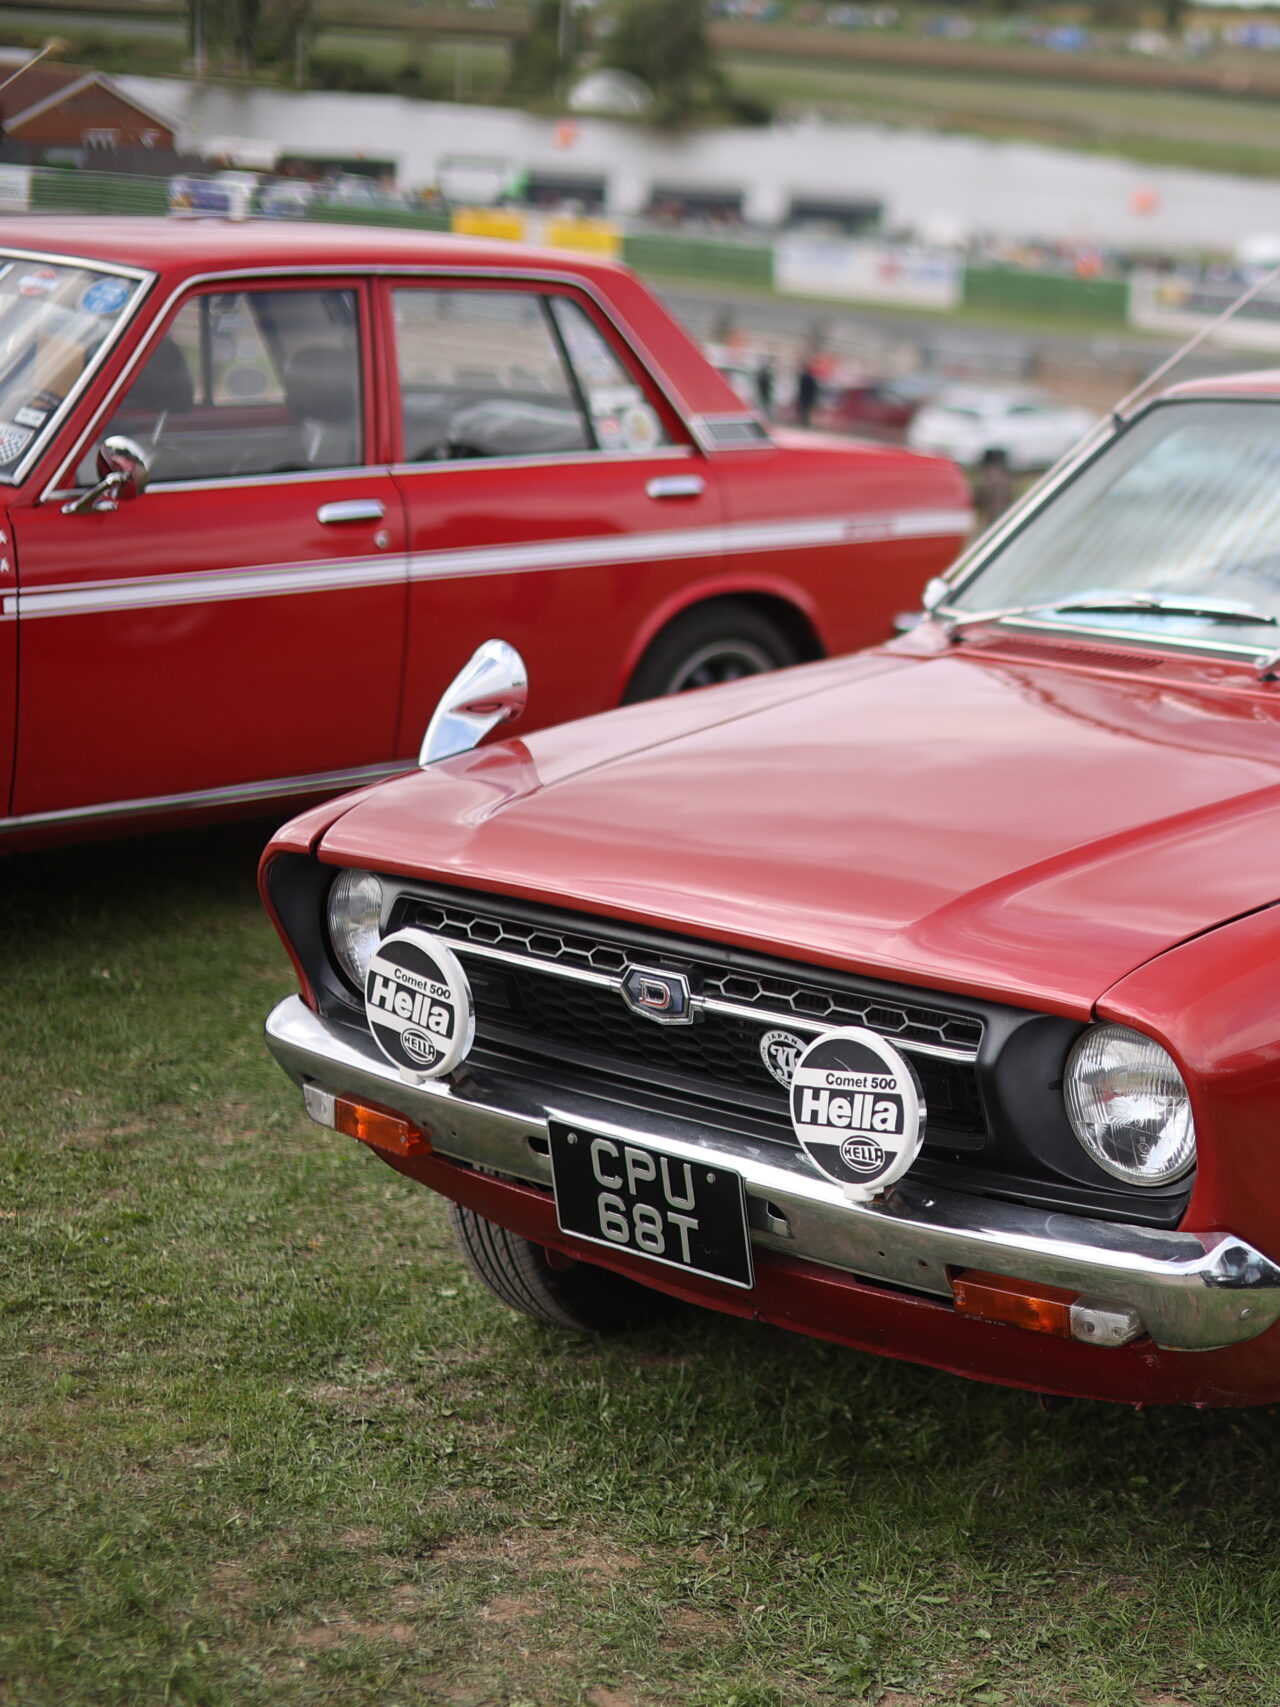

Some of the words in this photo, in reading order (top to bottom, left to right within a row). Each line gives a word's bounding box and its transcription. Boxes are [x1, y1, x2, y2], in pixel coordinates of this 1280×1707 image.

[394, 968, 427, 992] Comet
[430, 985, 451, 1000] 500
[370, 974, 449, 1036] Hella
[404, 1035, 436, 1059] HELLA
[767, 1033, 798, 1045] JAPAN
[825, 1072, 868, 1088] Comet
[871, 1077, 897, 1090] 500
[801, 1088, 898, 1132] Hella
[844, 1146, 884, 1164] HELLA
[590, 1138, 696, 1211] CPU
[598, 1192, 699, 1264] 68T
